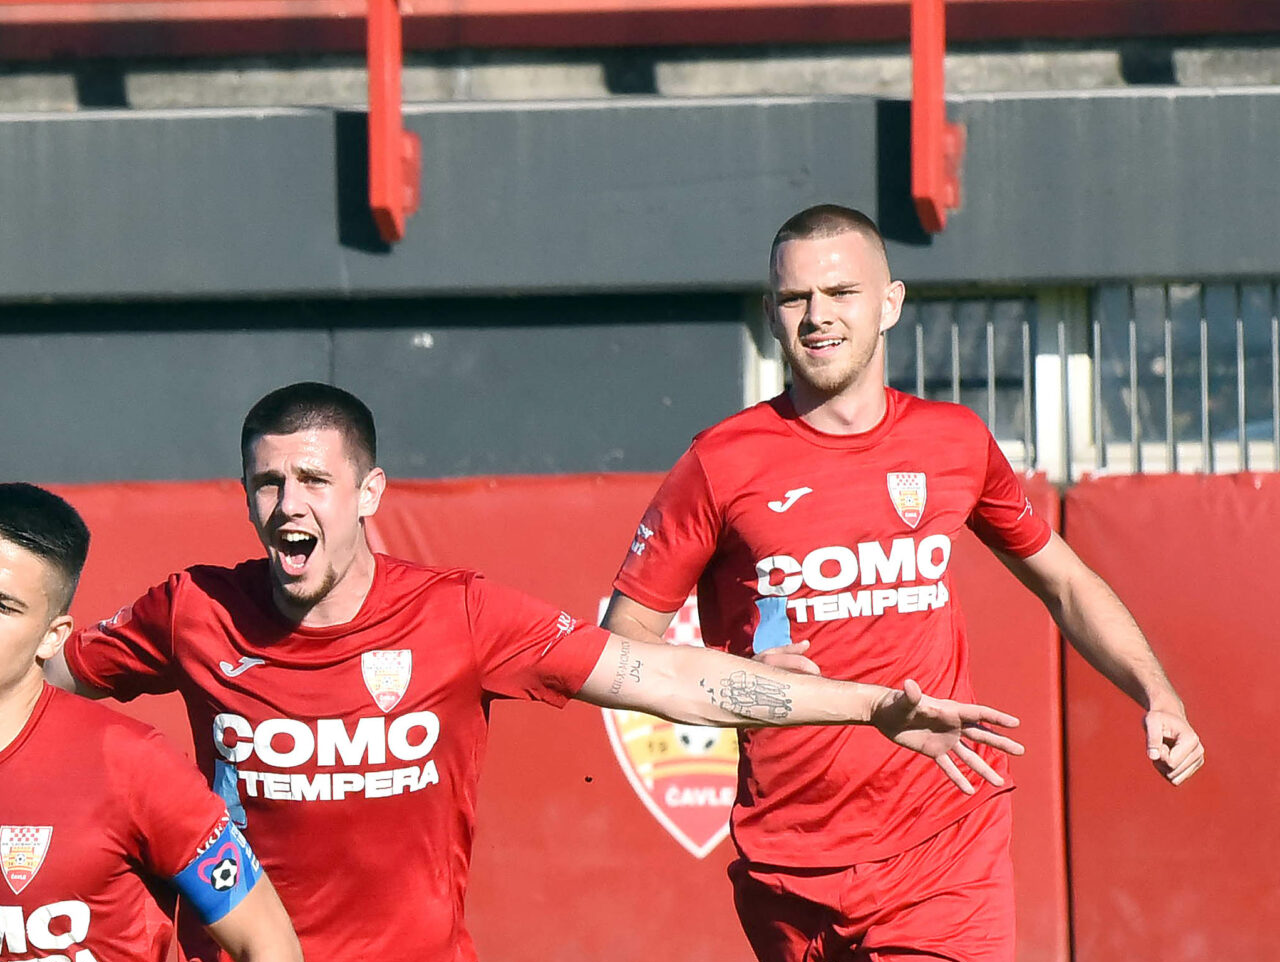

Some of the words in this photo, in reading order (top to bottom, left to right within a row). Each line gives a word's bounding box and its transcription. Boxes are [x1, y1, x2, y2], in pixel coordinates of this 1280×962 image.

[755, 533, 952, 597] COMO
[786, 580, 950, 623] TEMPERA
[213, 710, 441, 768] COMO
[237, 759, 440, 802] TEMPERA
